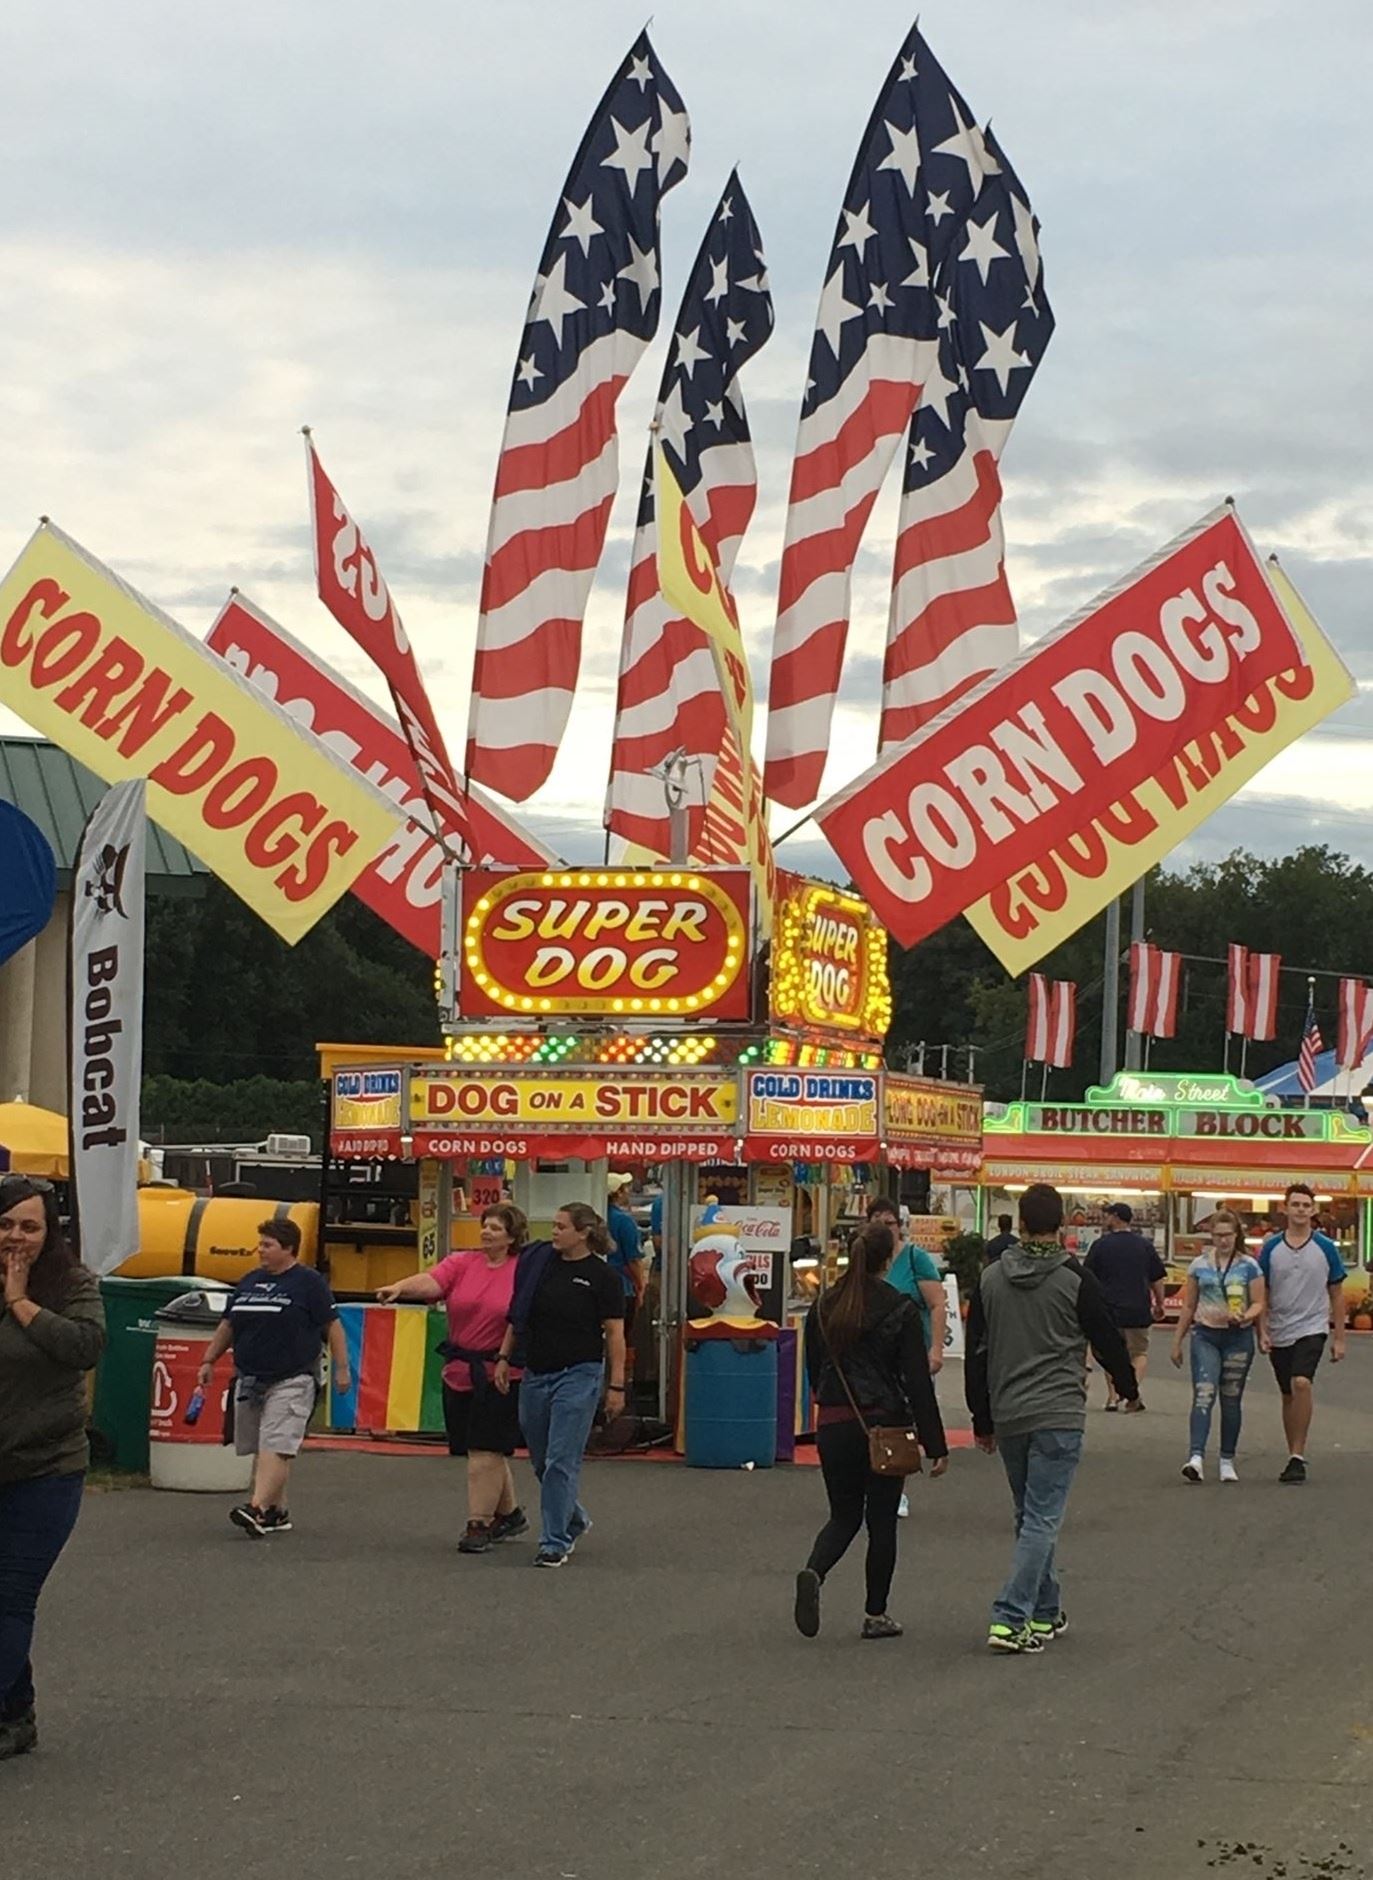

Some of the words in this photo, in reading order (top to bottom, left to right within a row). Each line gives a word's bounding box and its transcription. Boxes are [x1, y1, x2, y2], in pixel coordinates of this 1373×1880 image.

[0, 578, 194, 759] CORN
[149, 711, 360, 903] DOGS
[862, 701, 1084, 903] CORN
[1051, 561, 1262, 766] DOGS
[492, 900, 707, 942] SUPER
[524, 947, 680, 990] DOG
[810, 959, 850, 1009] DOG
[82, 945, 127, 1151] Bobcat
[427, 1084, 519, 1117] DOG
[529, 1092, 561, 1108] ON
[569, 1091, 586, 1110] A
[595, 1085, 719, 1118] STICK
[753, 1074, 800, 1099] COLD
[806, 1074, 875, 1101] DRINKS
[1174, 1079, 1231, 1102] Street
[750, 1101, 877, 1134] LEMONADE
[1041, 1109, 1166, 1134] BUTCHER
[1195, 1112, 1307, 1138] BLOCK
[428, 1138, 476, 1154] CORN
[478, 1140, 527, 1155] DOGS
[606, 1142, 656, 1157] HAND
[657, 1141, 718, 1157] DIPPED
[769, 1143, 810, 1159] CORN
[813, 1144, 857, 1160] DOGS
[473, 1189, 500, 1207] 320
